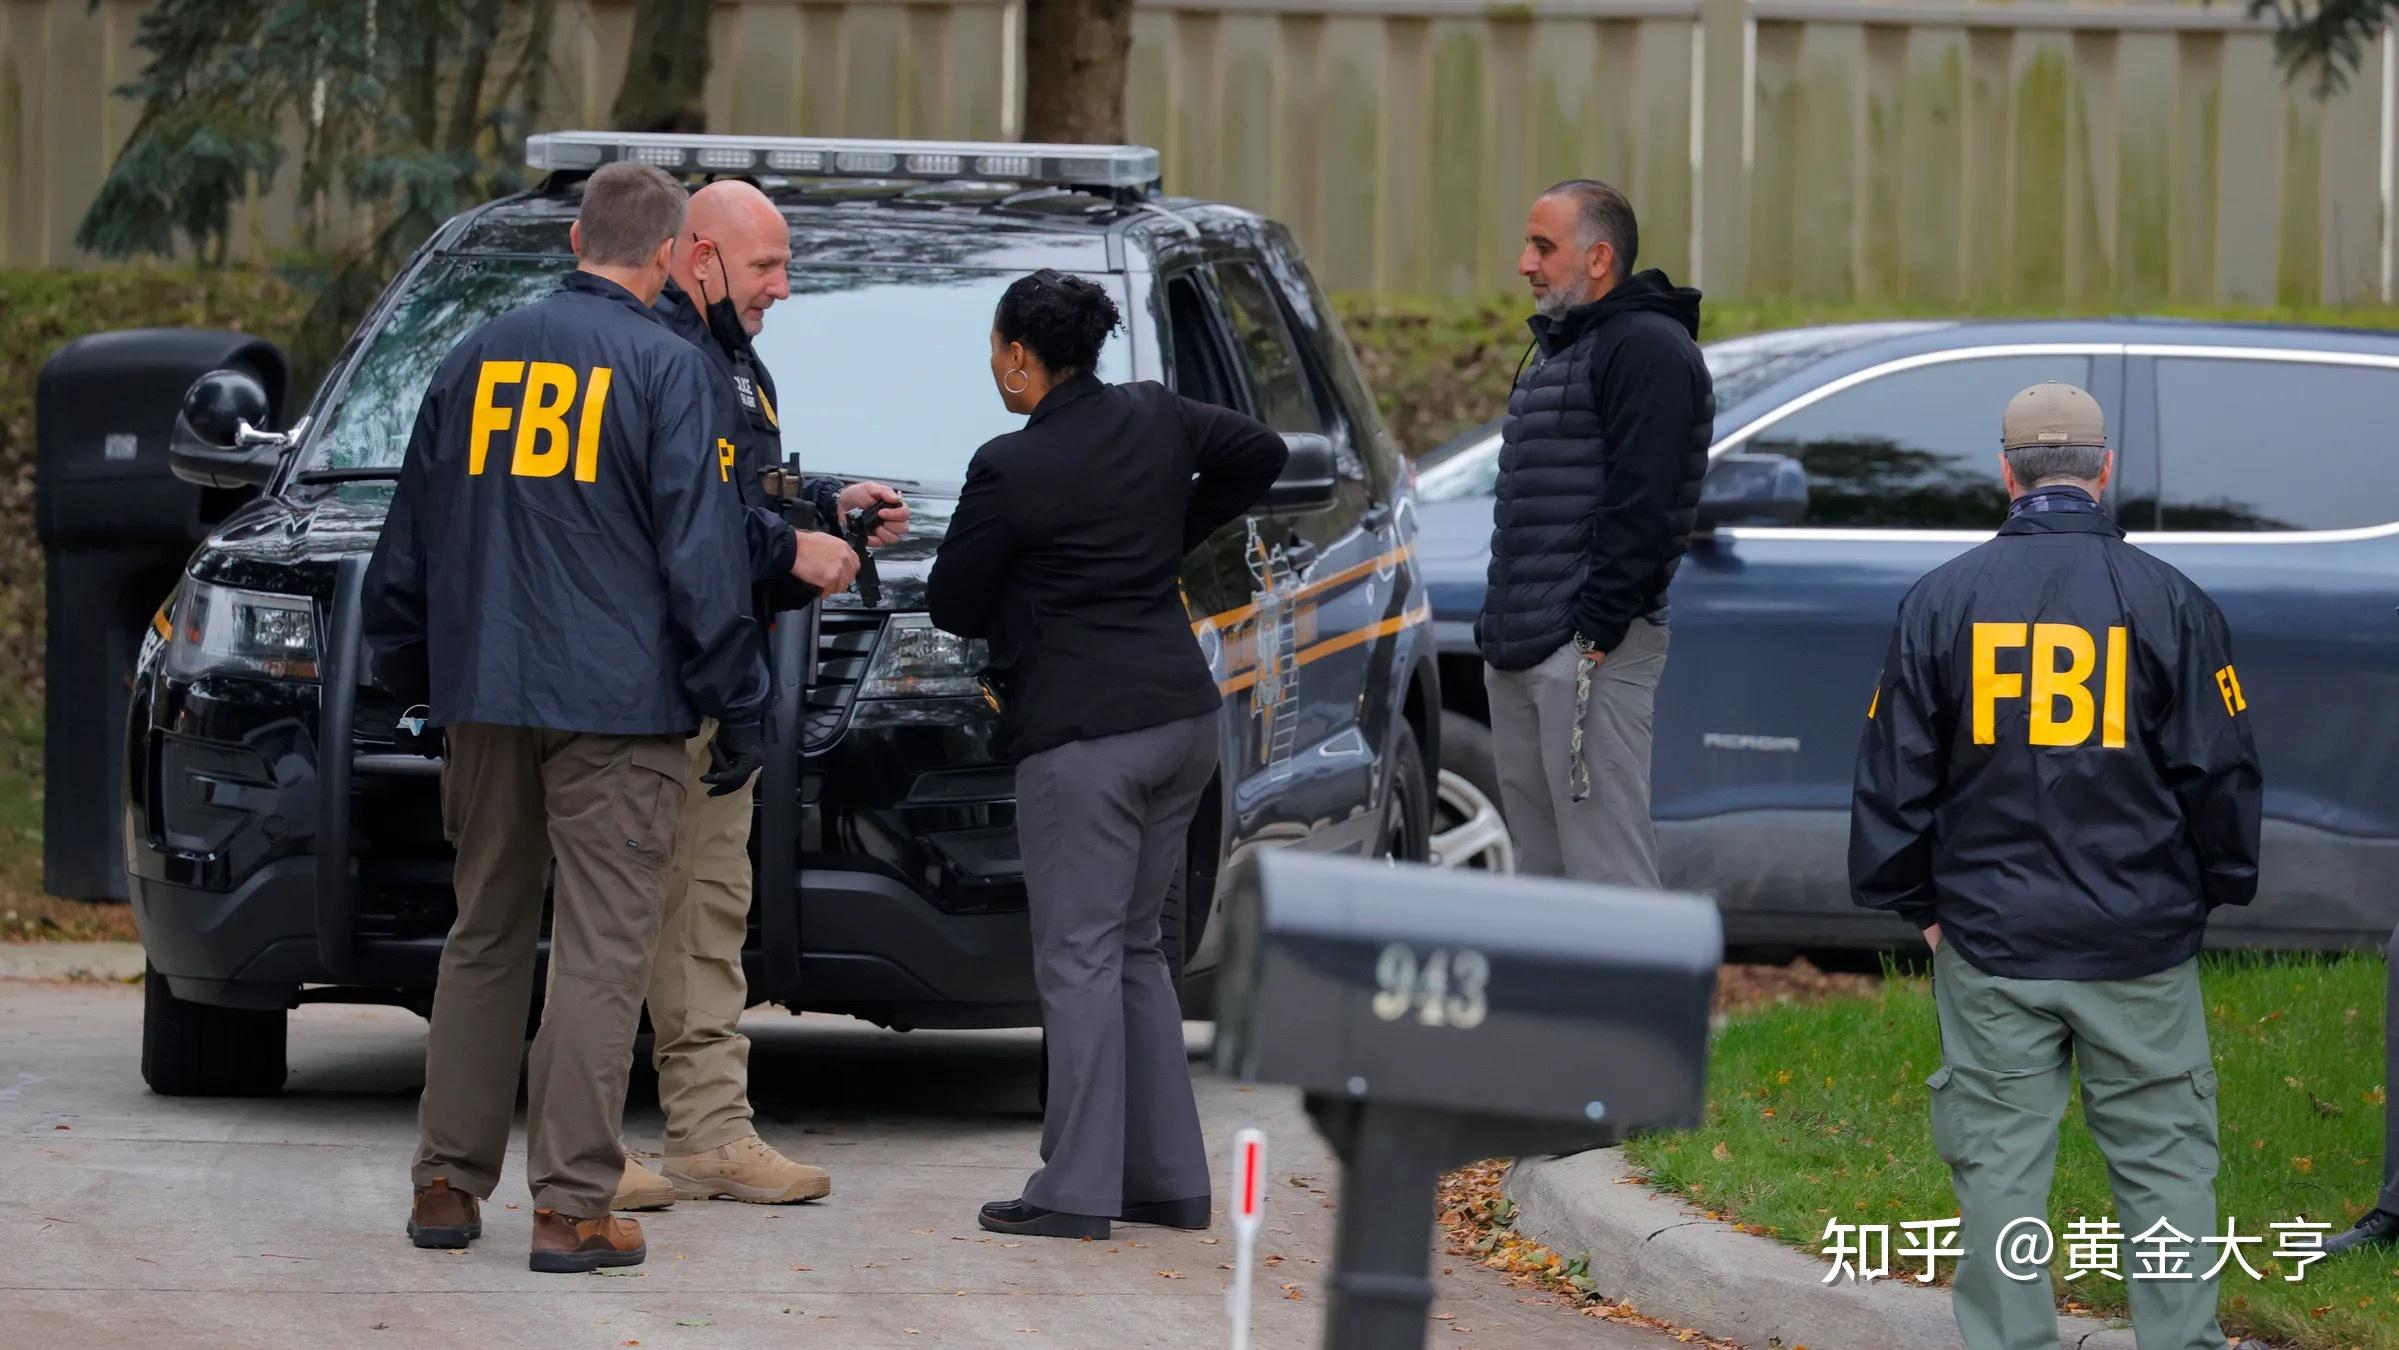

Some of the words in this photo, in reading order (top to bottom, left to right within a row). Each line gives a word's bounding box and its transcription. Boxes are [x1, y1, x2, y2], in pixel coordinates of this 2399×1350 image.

[468, 360, 613, 483] FBI
[1972, 622, 2127, 748] FBI
[1373, 943, 1489, 1028] 943
